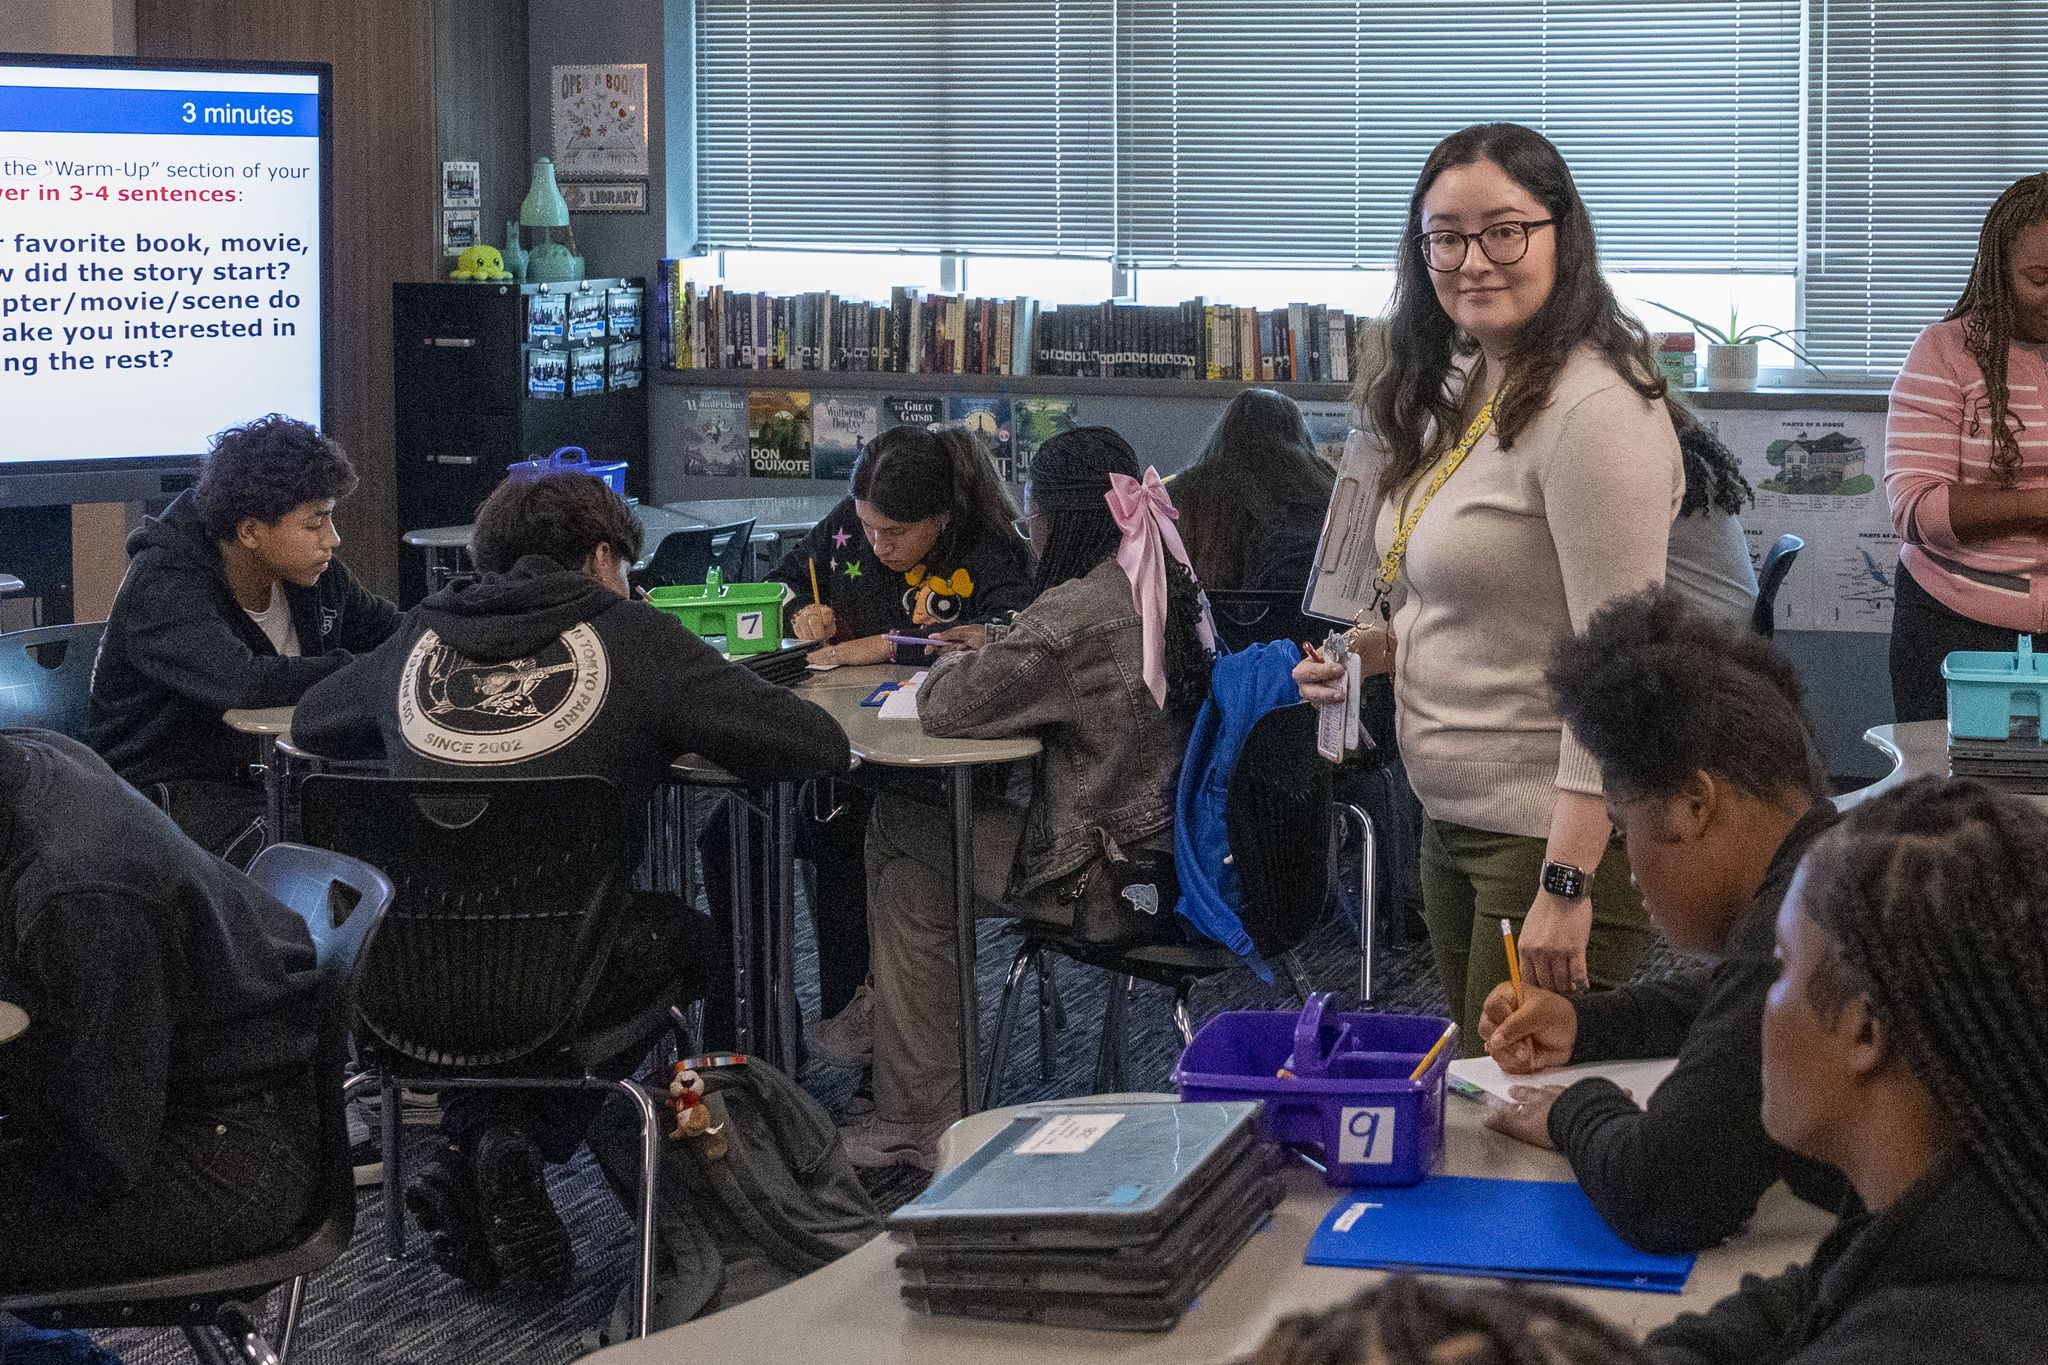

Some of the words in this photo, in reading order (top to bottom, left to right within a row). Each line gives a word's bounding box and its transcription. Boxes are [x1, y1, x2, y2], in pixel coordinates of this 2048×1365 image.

[182, 103, 197, 123] 3
[204, 103, 294, 125] minutes
[4, 160, 37, 176] the
[167, 162, 235, 178] section
[243, 163, 262, 179] of
[268, 166, 311, 182] your
[39, 184, 60, 201] in
[69, 185, 110, 202] 3-4
[118, 186, 244, 203] sentences:
[589, 191, 638, 204] LIBRARY
[14, 233, 126, 253] favorite
[136, 232, 210, 256] book,
[221, 232, 309, 256] movie,
[25, 262, 68, 283] did
[78, 262, 124, 283] the
[133, 264, 204, 286] story
[213, 261, 291, 282] start?
[268, 289, 301, 310] do
[63, 326, 114, 346] you
[124, 318, 264, 339] interested
[273, 317, 297, 338] in
[48, 350, 95, 372] the
[104, 348, 174, 370] rest?
[901, 411, 934, 423] GATSBY
[904, 400, 934, 412] GREAT
[751, 448, 780, 460] DON
[754, 459, 810, 472] QUIXOTE
[741, 614, 760, 634] 7
[580, 640, 599, 691] TOKYO
[403, 700, 415, 725] LOS
[554, 693, 591, 733] PARIS
[424, 732, 474, 754] SINCE
[478, 739, 523, 754] 2002
[1348, 1111, 1380, 1158] 9
